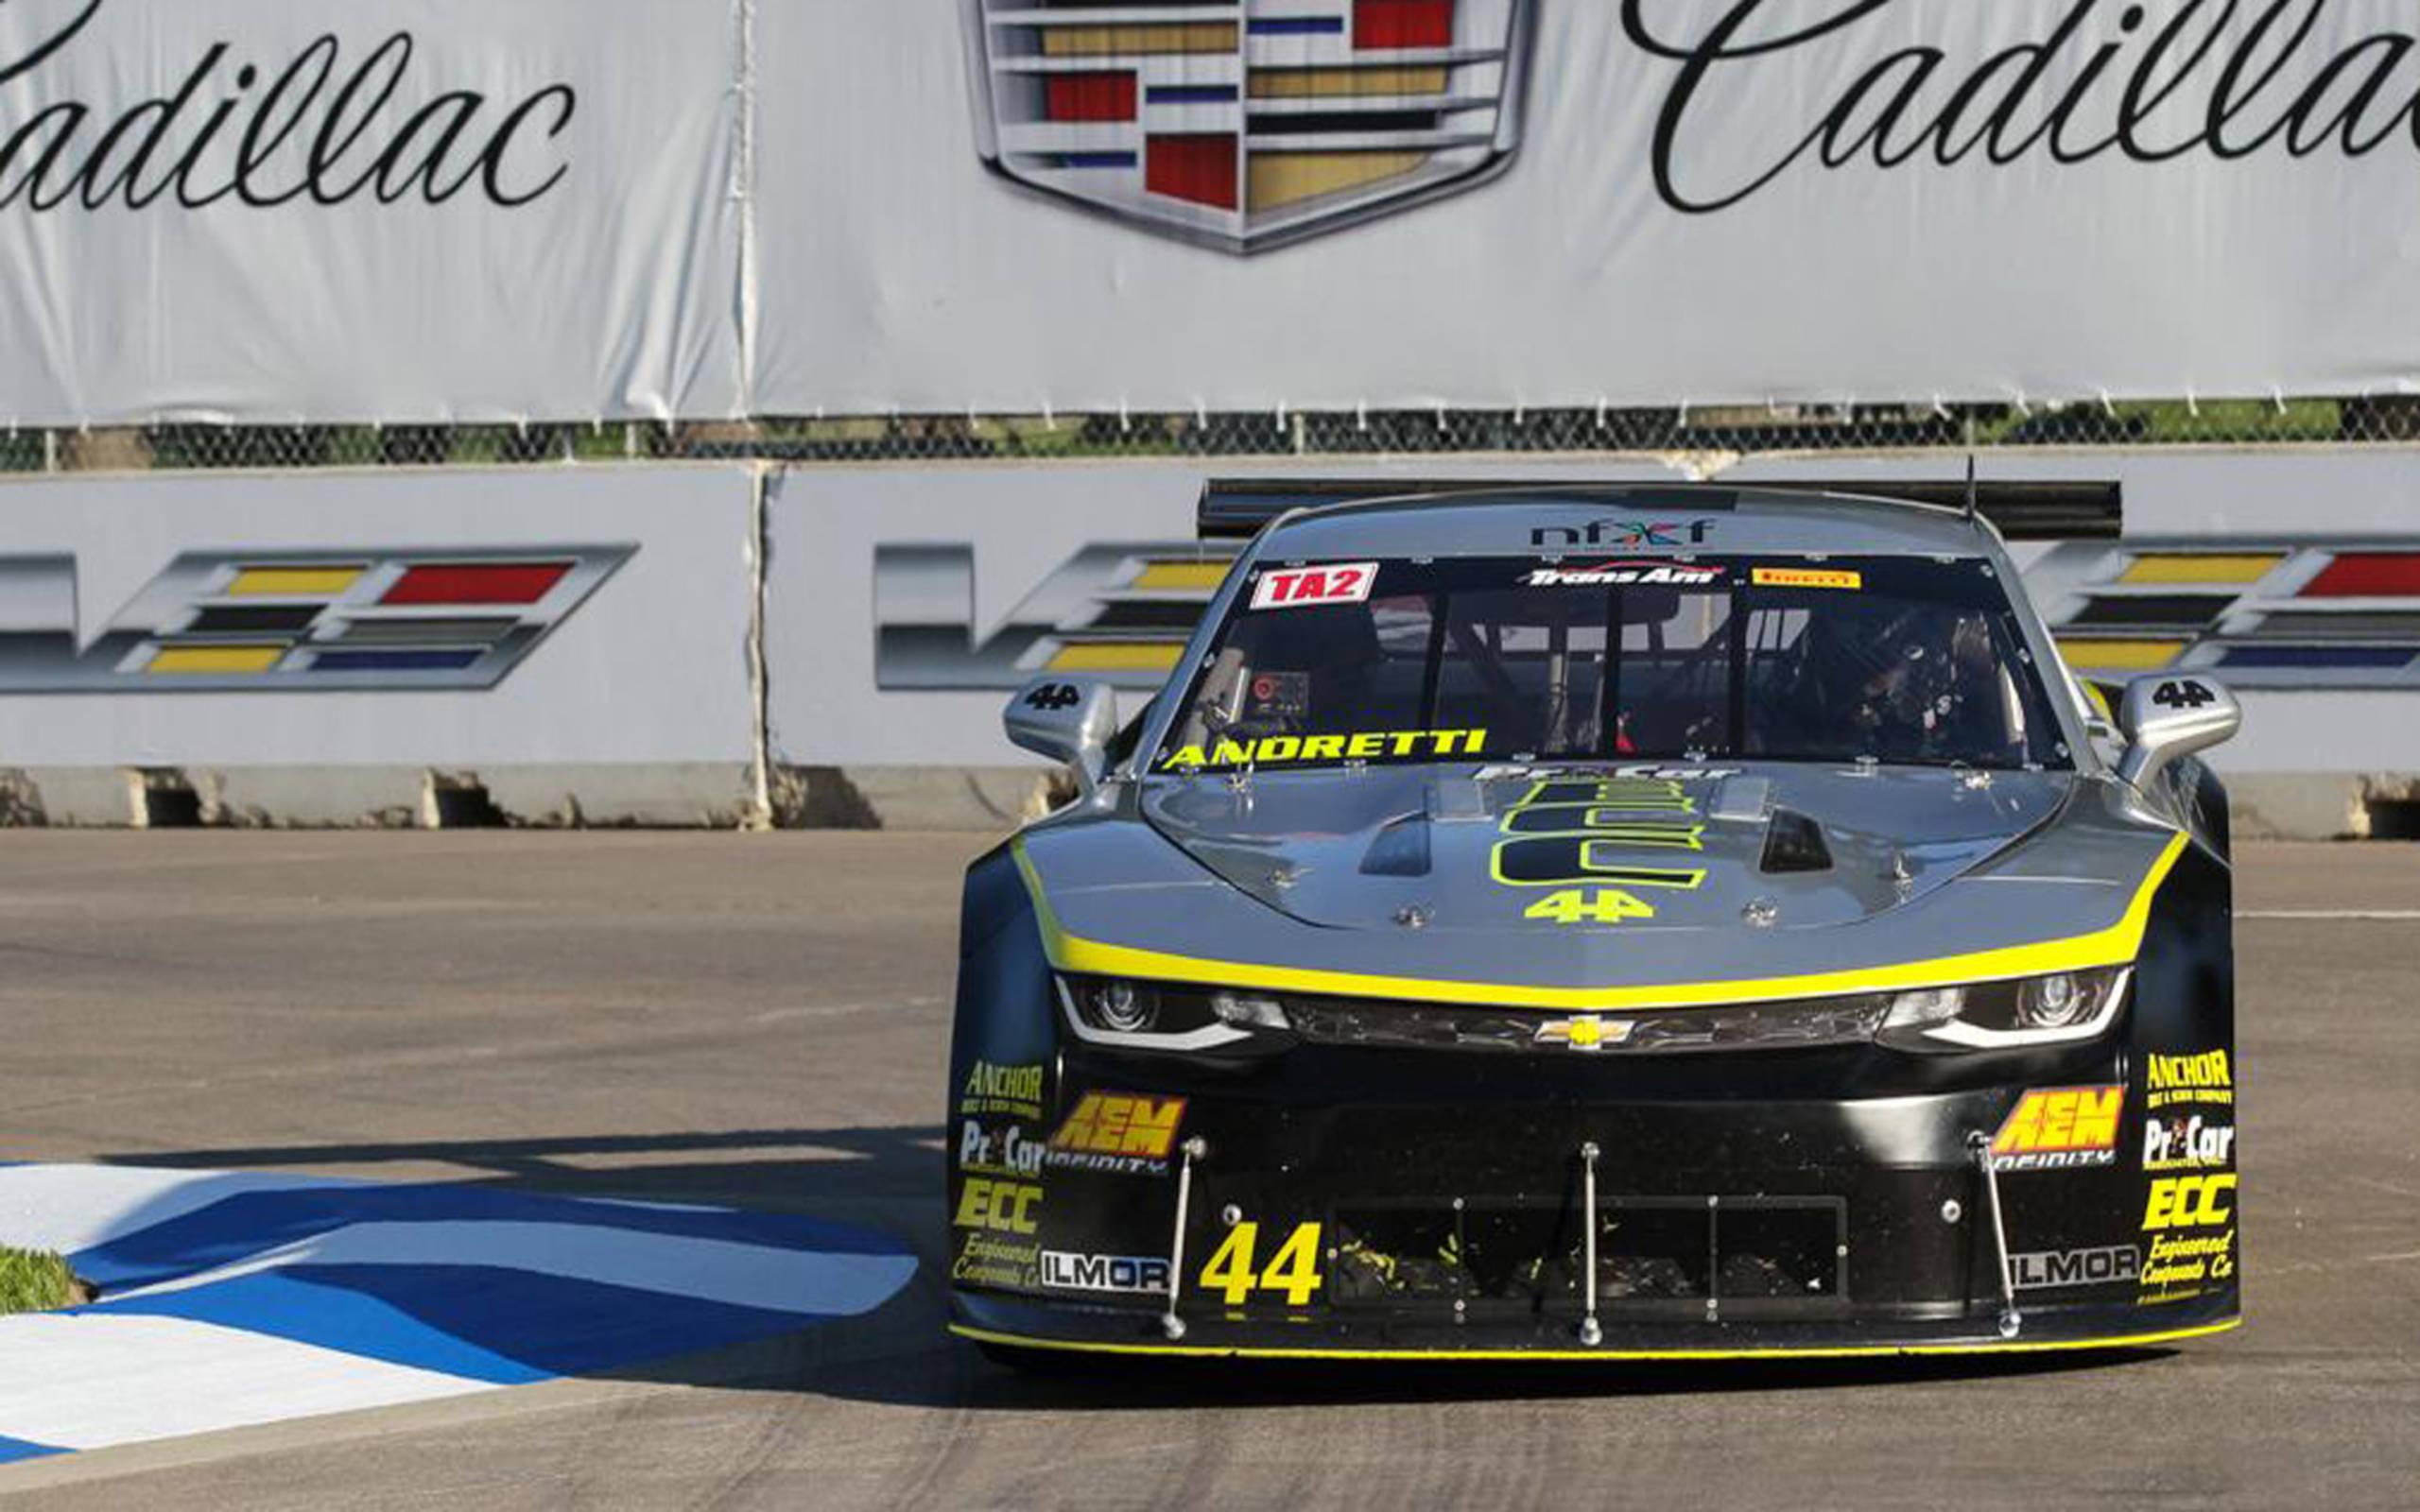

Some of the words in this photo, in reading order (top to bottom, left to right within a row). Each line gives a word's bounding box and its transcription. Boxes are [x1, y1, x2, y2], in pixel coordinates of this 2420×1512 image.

[0, 0, 576, 212] adillac
[1620, 0, 2420, 215] Cadilla
[1271, 571, 1362, 601] TA2
[1526, 569, 1640, 586] Trans
[1637, 567, 1717, 584] Am
[1162, 729, 1487, 770] ANDRETTI
[964, 1061, 1043, 1101] ANCHOR
[2147, 1049, 2231, 1089] ANCHOR
[1051, 1092, 1185, 1158] AEM
[1991, 1088, 2123, 1152] AEM
[2143, 1115, 2235, 1164] PrCar
[954, 1177, 1044, 1233] ECC
[2141, 1174, 2238, 1230] ECC
[1044, 1254, 1170, 1287] ILMOR
[1200, 1222, 1322, 1305] 44
